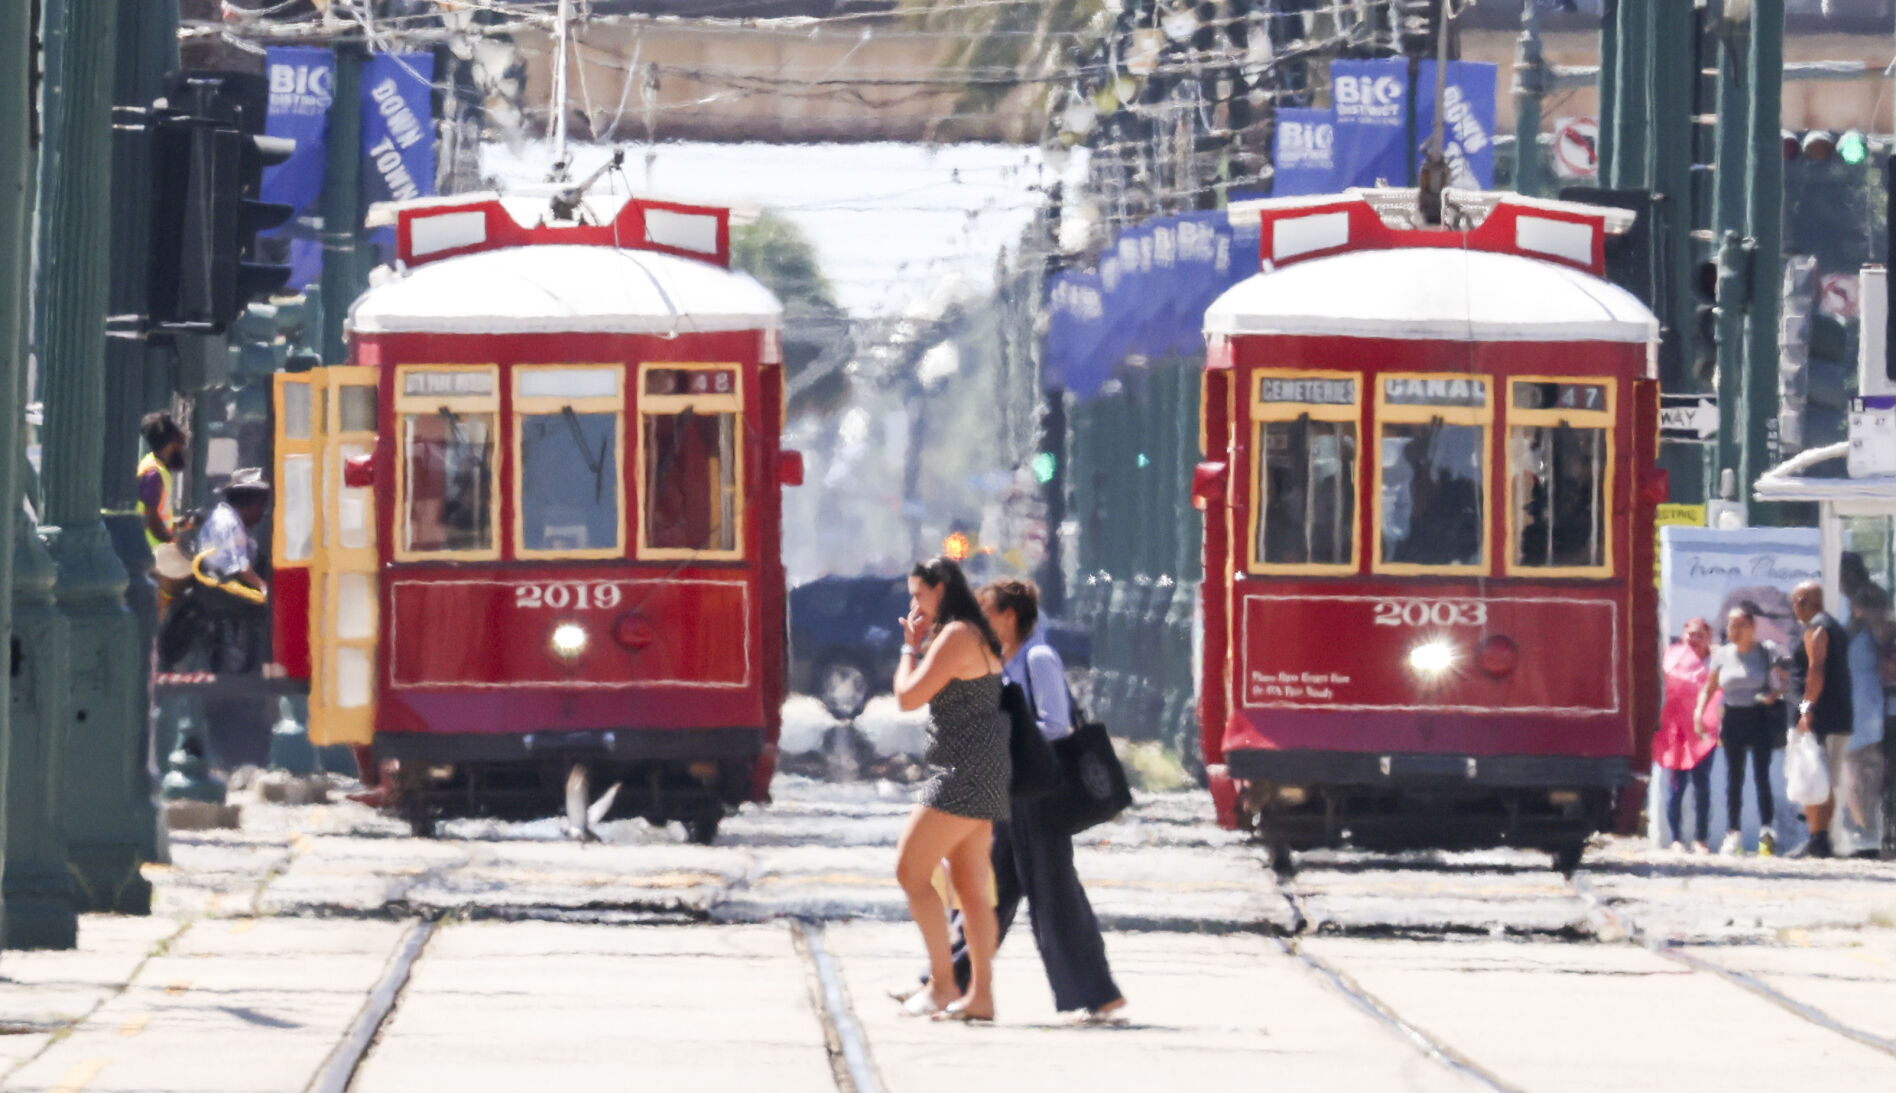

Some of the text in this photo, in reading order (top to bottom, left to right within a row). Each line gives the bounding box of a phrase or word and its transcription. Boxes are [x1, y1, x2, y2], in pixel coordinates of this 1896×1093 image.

[1262, 379, 1354, 402] CEMETERIES
[1385, 379, 1485, 398] CANAL
[1661, 409, 1696, 426] WAY
[515, 583, 622, 609] 2019
[1373, 602, 1488, 626] 2003
